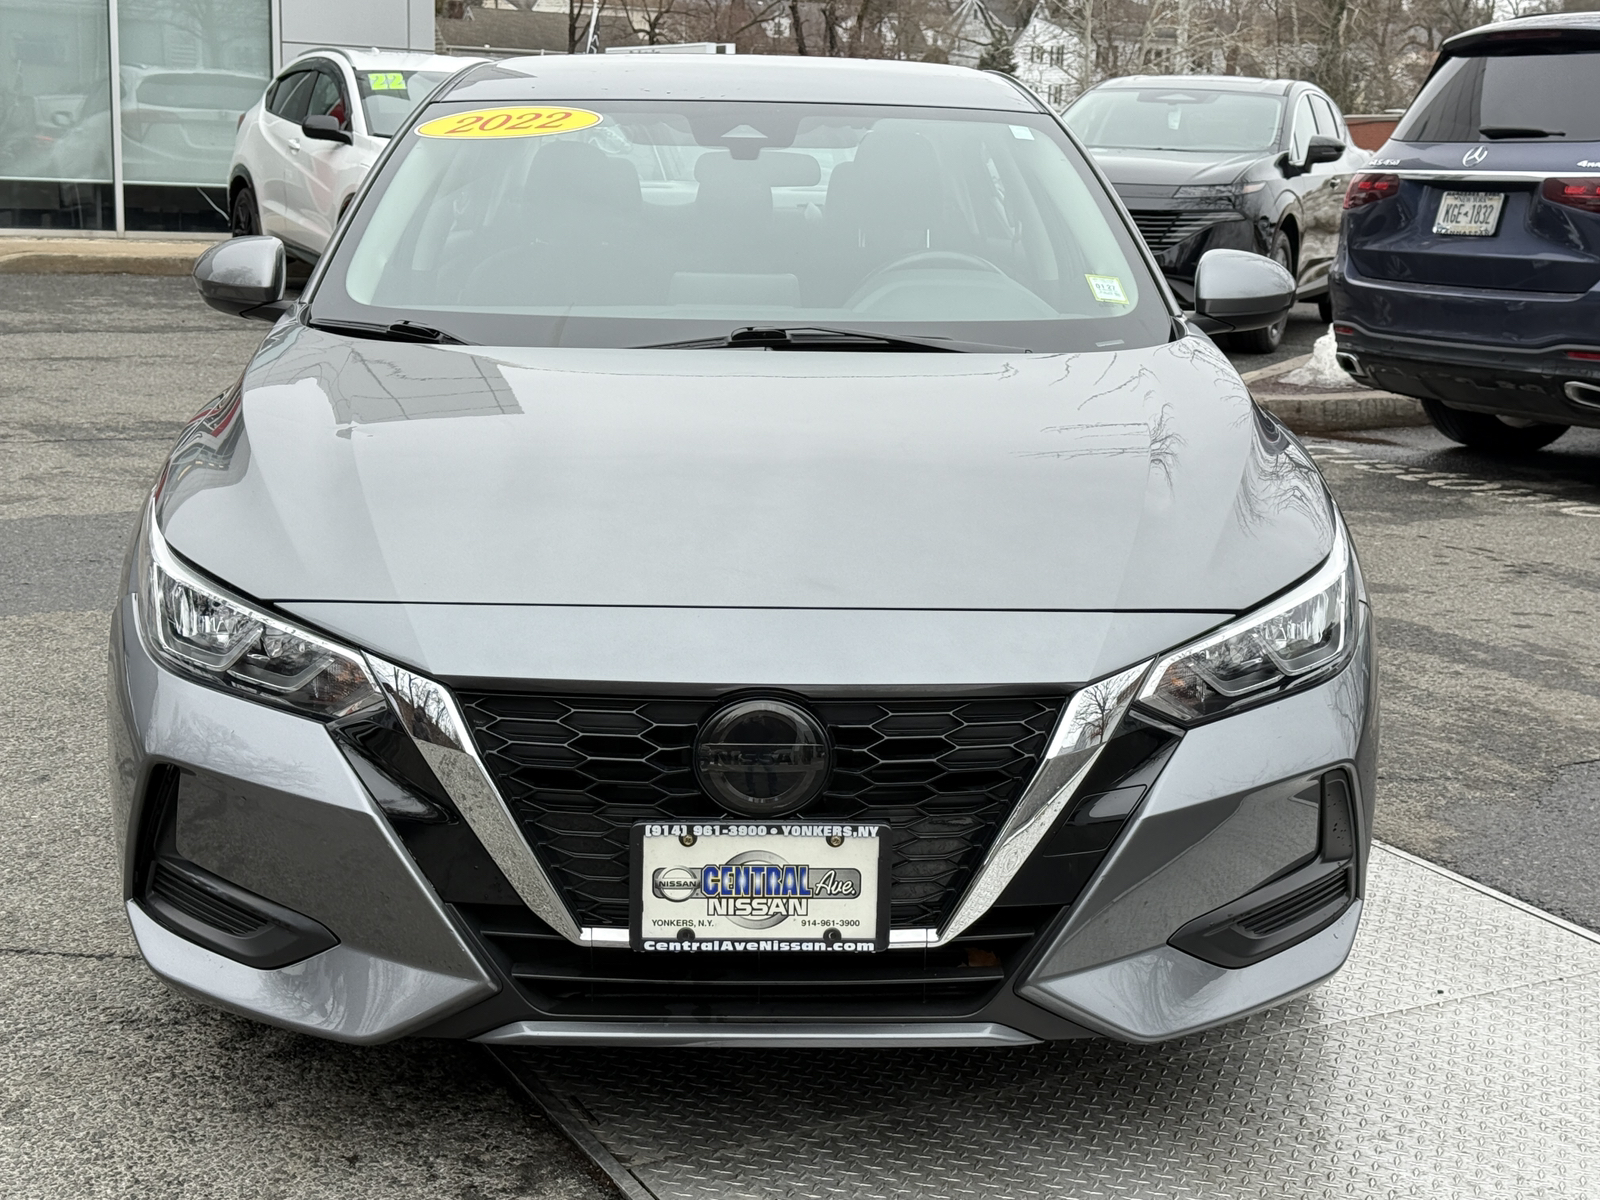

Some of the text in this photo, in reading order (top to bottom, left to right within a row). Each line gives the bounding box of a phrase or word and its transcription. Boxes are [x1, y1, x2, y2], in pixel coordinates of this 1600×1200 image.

[369, 72, 407, 91] 22
[444, 111, 573, 135] 2022
[1442, 203, 1495, 225] KGE 1832
[693, 825, 767, 837] 961-3900
[658, 880, 697, 888] NISSAN
[701, 864, 857, 898] CENTRAL Ave.
[707, 897, 809, 917] NISSAN
[651, 919, 715, 928] YONKERS, N.Y.
[800, 919, 861, 928] 914-961-3900
[643, 939, 876, 952] CentralAveNissan.com
